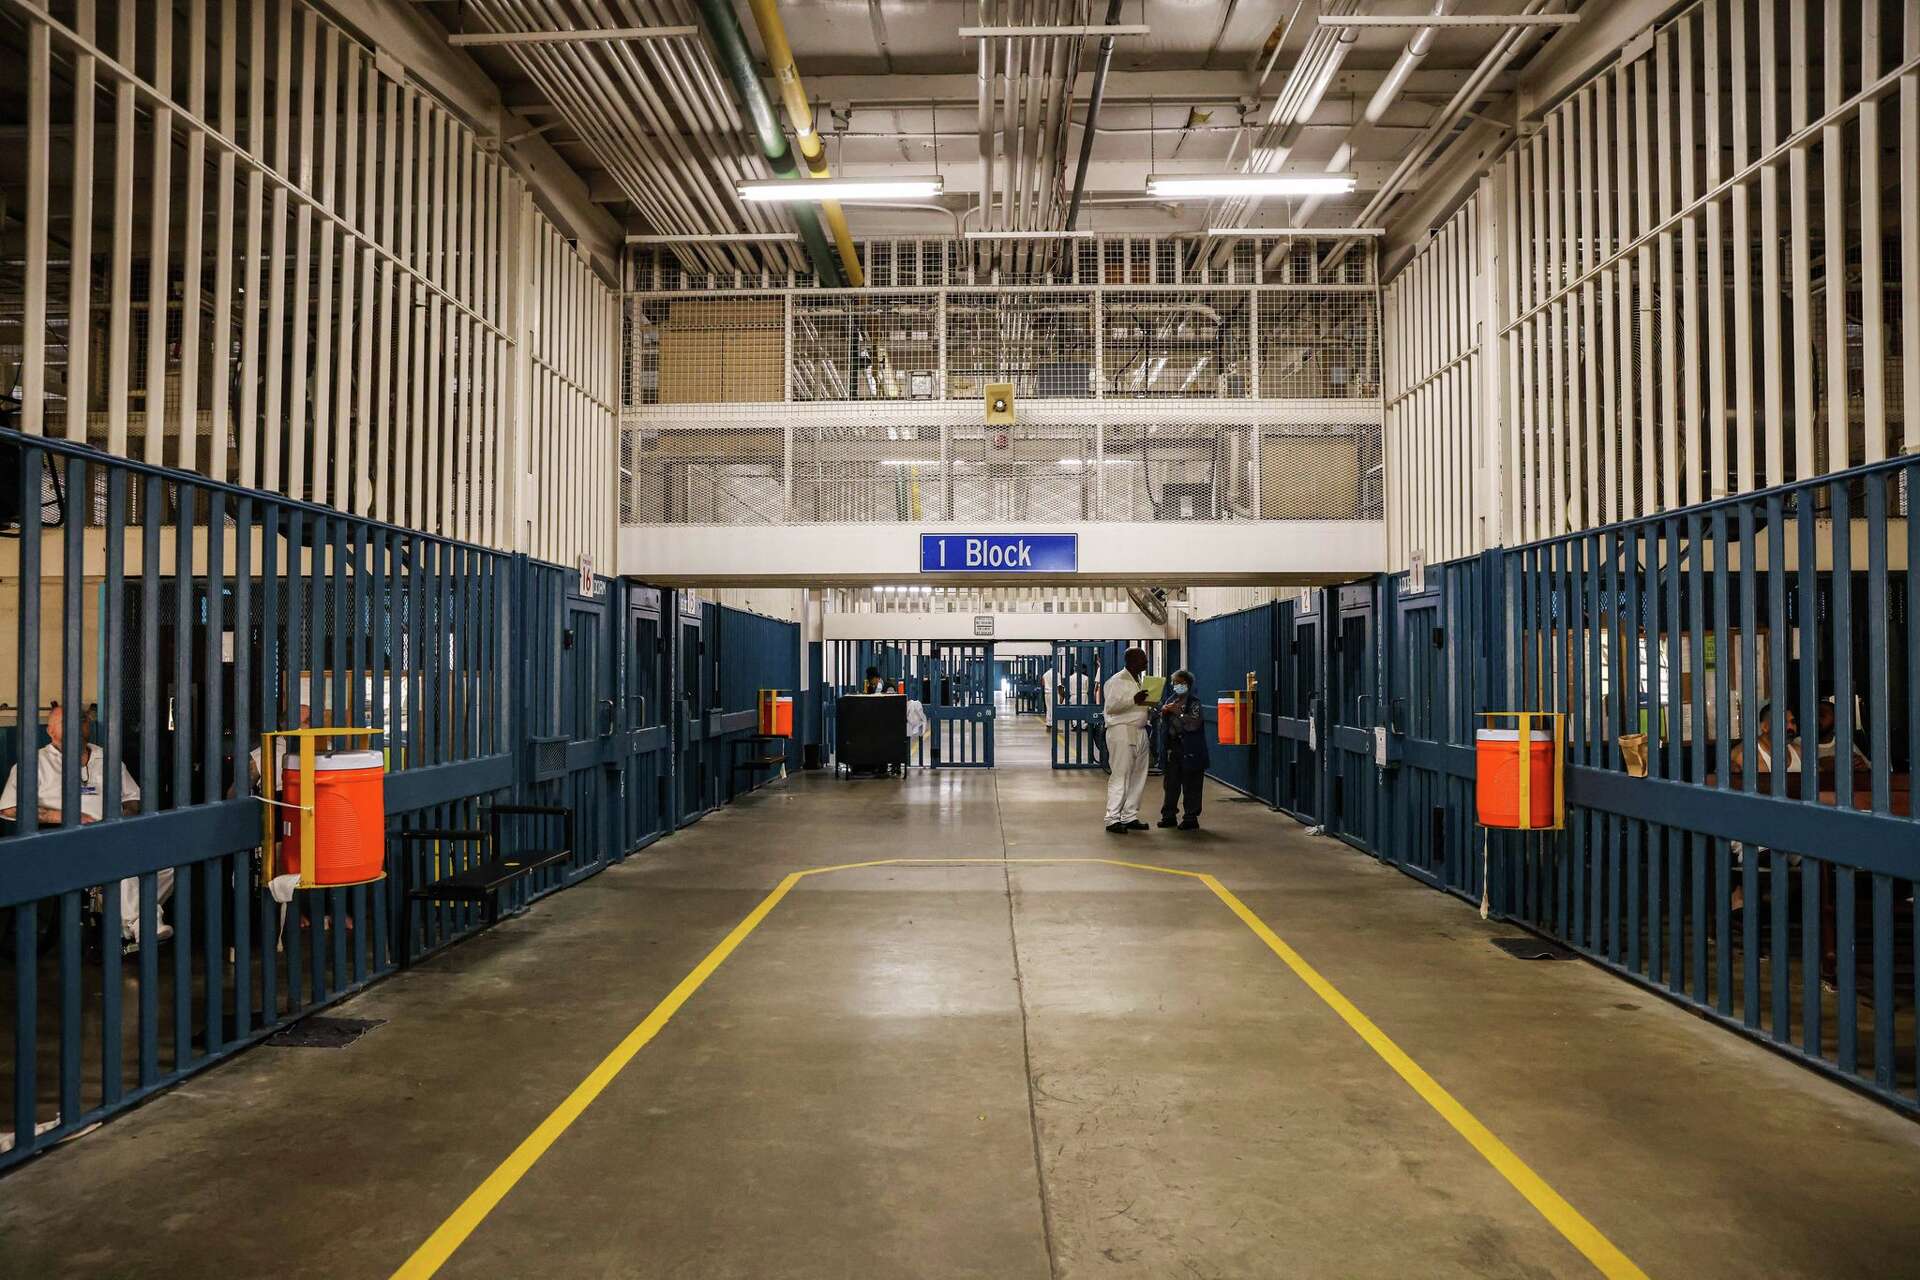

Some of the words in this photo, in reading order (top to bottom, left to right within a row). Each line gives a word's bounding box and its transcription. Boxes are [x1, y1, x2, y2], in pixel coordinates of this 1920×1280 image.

[938, 539, 945, 567] 1
[966, 538, 1032, 567] Block
[583, 567, 592, 591] 16
